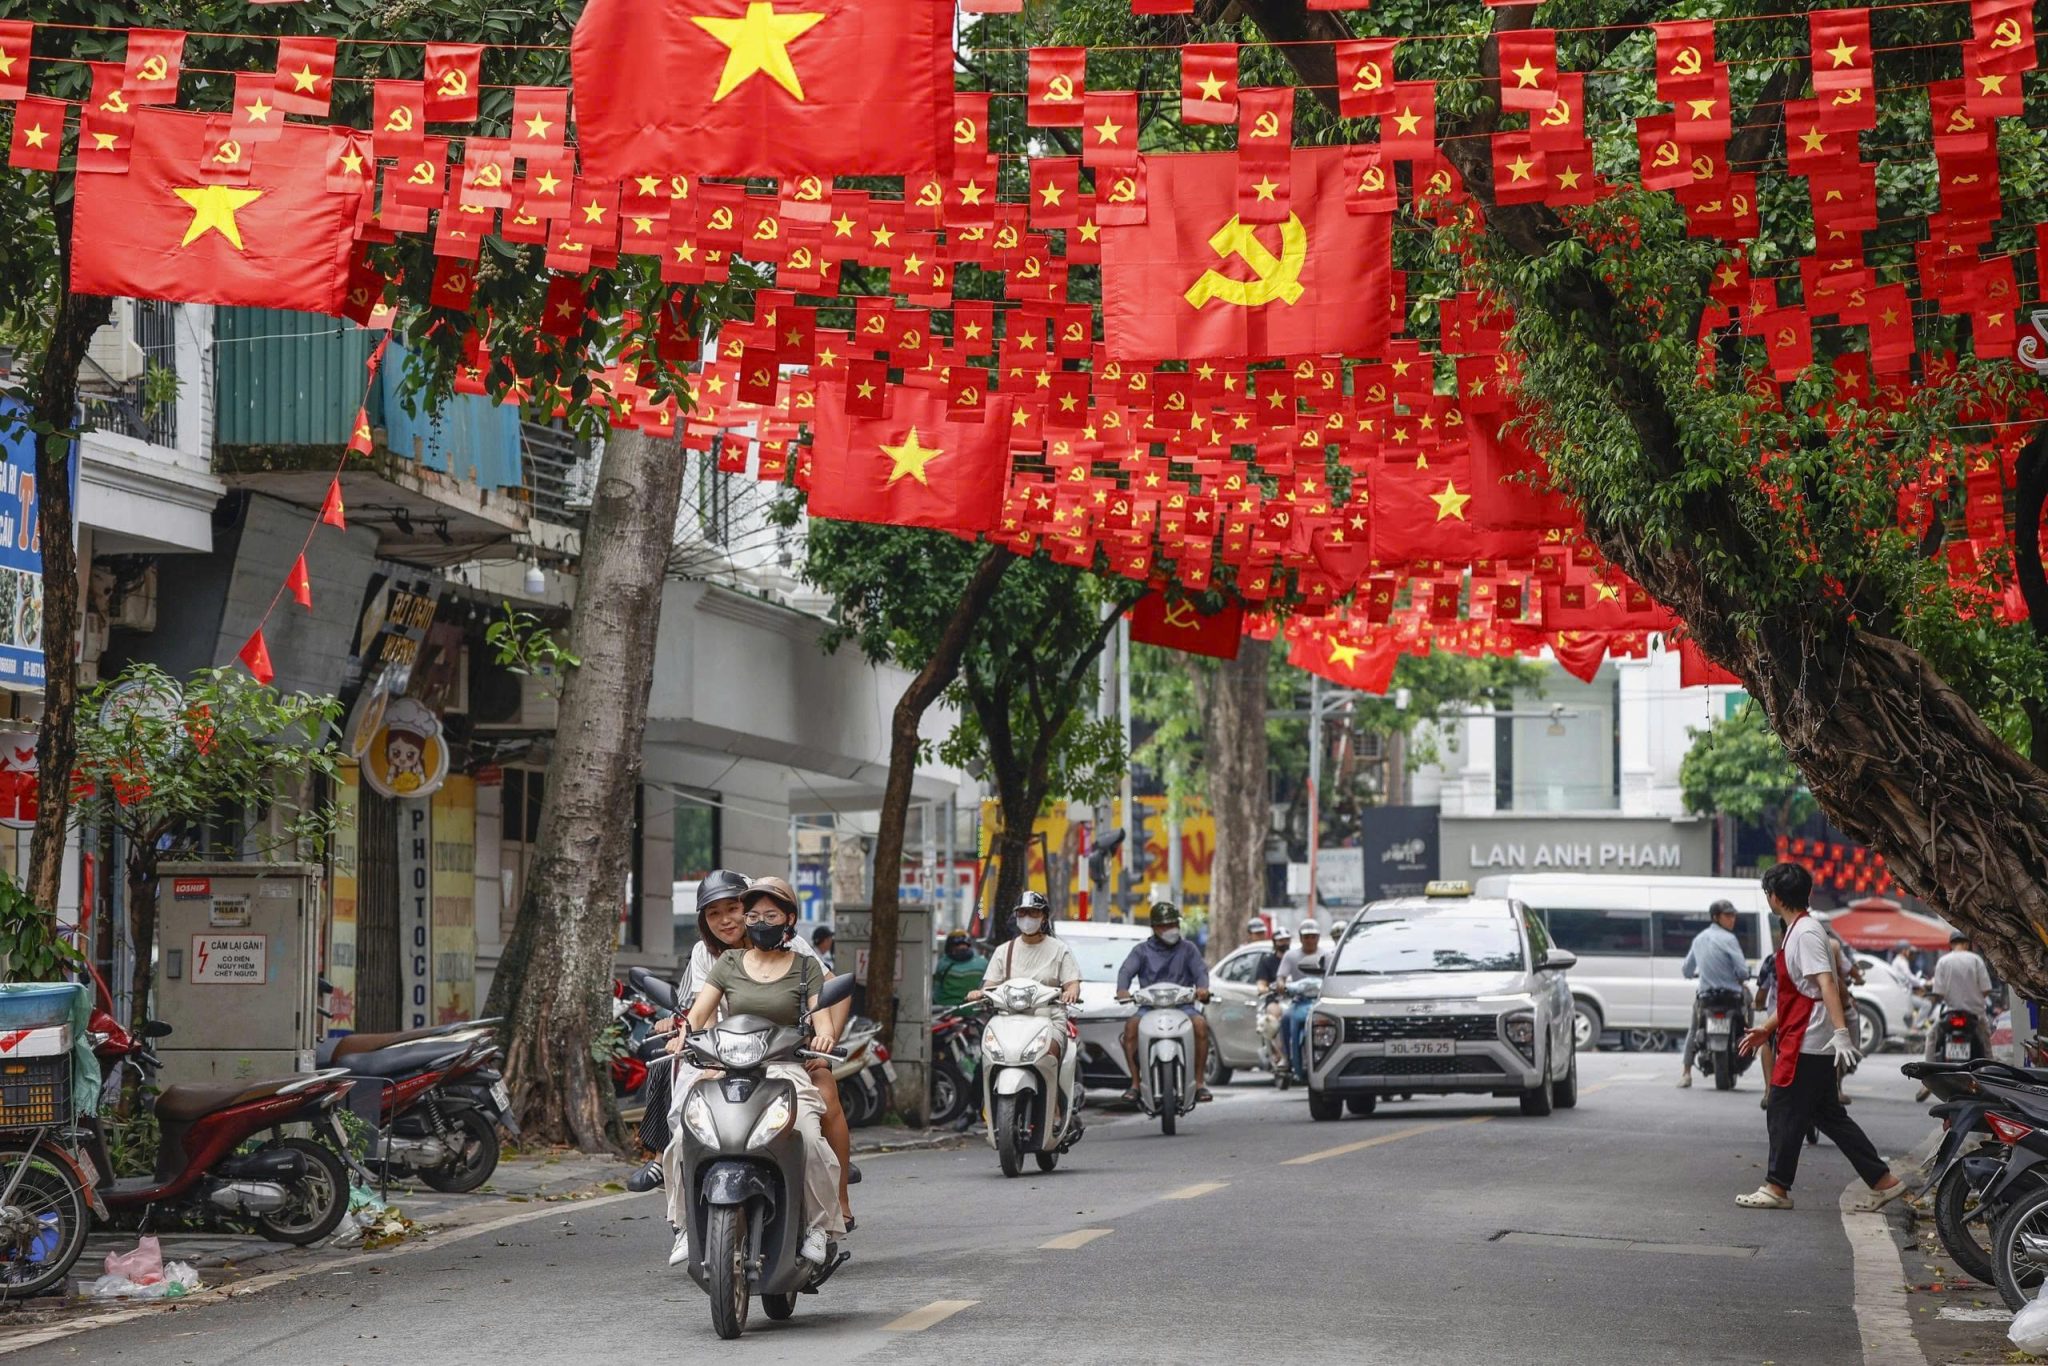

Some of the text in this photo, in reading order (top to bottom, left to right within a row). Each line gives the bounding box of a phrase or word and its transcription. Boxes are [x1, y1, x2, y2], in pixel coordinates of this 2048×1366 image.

[1470, 844, 1681, 867] LAN ANH PHAM
[175, 884, 206, 893] LOSHIP
[1434, 881, 1464, 891] TAXI
